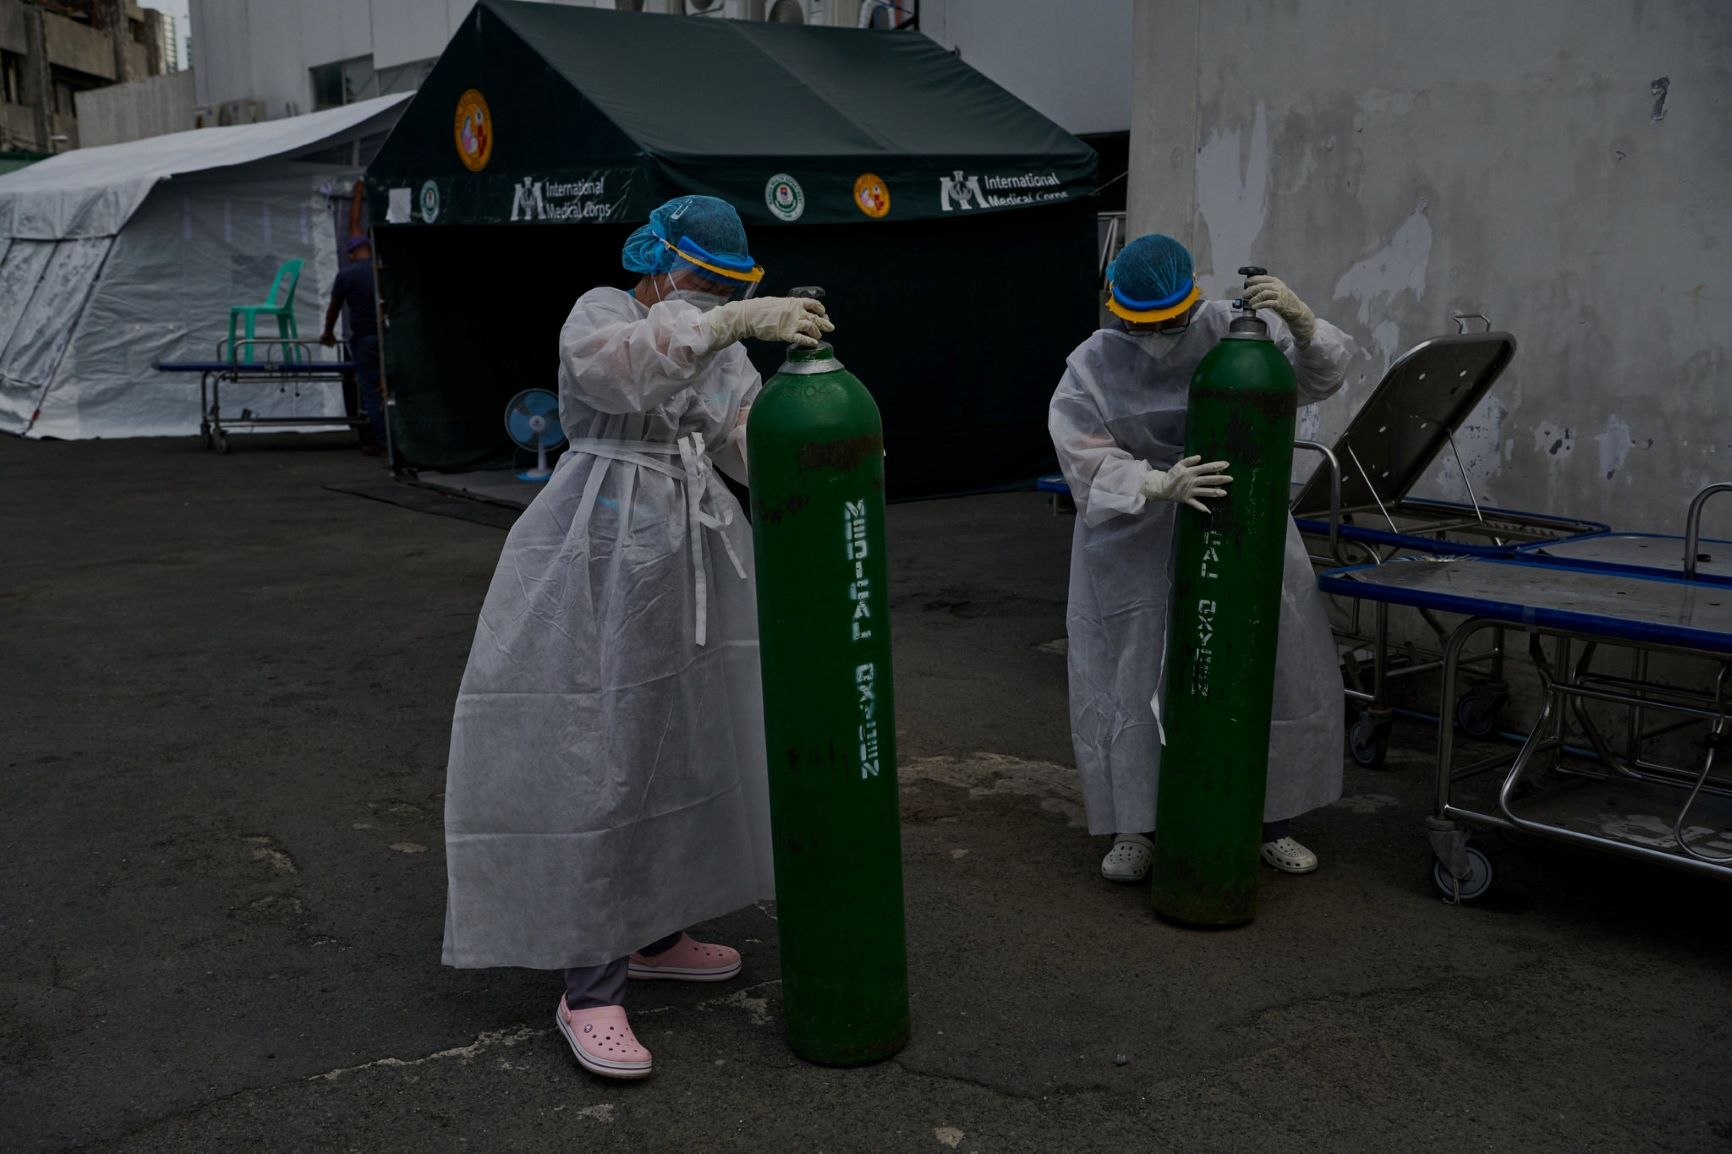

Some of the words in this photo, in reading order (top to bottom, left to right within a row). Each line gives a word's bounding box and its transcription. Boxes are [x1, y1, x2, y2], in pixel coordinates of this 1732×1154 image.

[546, 176, 604, 197] International
[984, 172, 1060, 190] International
[987, 194, 1033, 207] Medical
[545, 201, 583, 219] Medical
[584, 201, 611, 221] Corps
[843, 498, 873, 642] MEDICAL
[855, 661, 880, 780] OXYGEN
